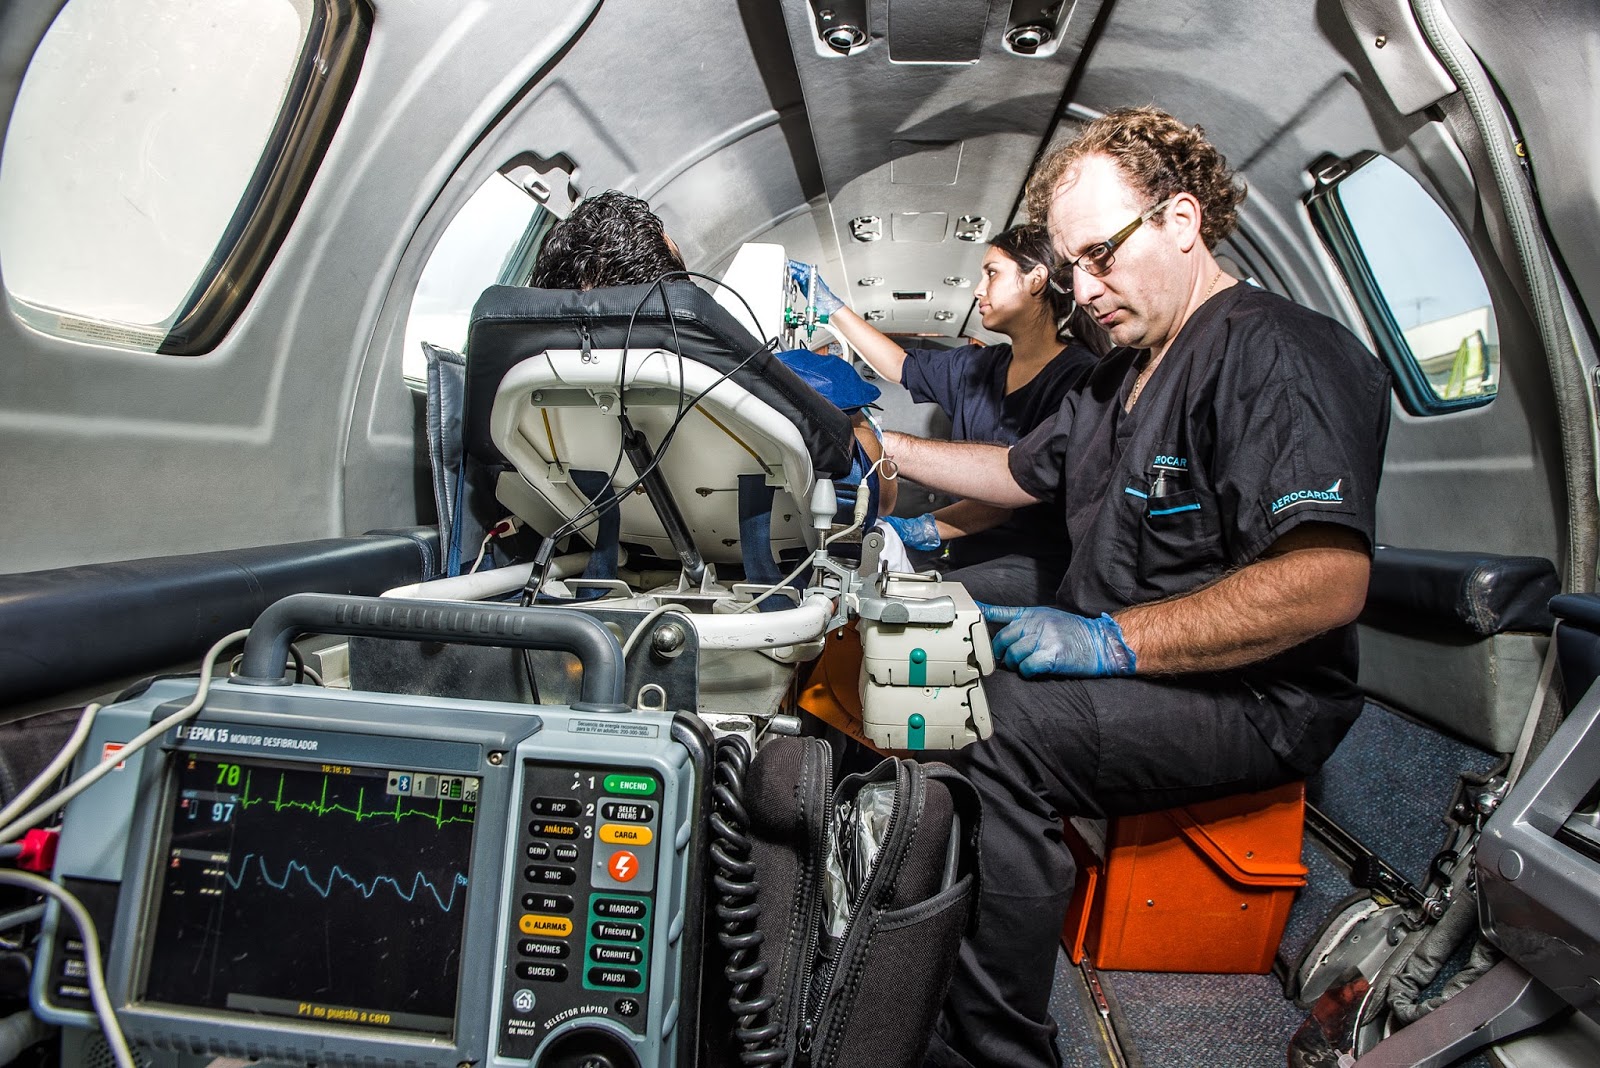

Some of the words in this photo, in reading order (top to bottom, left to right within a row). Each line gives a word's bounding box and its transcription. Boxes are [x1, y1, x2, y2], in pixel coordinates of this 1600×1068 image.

[1272, 490, 1343, 512] AEROCARDAL
[216, 729, 228, 742] 15
[230, 734, 262, 746] MONITOR
[262, 736, 318, 750] DESFIBRILADOR
[216, 763, 240, 786] 70
[417, 780, 422, 790] 1
[442, 782, 448, 794] 2
[588, 776, 595, 790] 1
[620, 780, 648, 791] ENCEND
[212, 802, 235, 822] 97
[552, 802, 567, 812] RCP
[586, 804, 594, 817] 2
[617, 812, 637, 820] ENERG
[544, 822, 574, 834] ANÁLISIS
[584, 826, 592, 839] 3
[614, 830, 638, 840] CARGA
[529, 846, 547, 856] DERIV
[544, 870, 562, 880] SINC
[544, 899, 556, 908] PNI
[610, 906, 640, 914] MARCAP
[534, 921, 566, 932] ALARMAS
[604, 928, 631, 937] FRECUEN
[526, 943, 560, 954] OPCIONES
[528, 967, 556, 977] SUCESO
[602, 972, 626, 983] PAUSA
[314, 1006, 326, 1016] no
[327, 1008, 358, 1020] puesto
[361, 1012, 367, 1021] a
[369, 1013, 390, 1024] cero
[544, 1007, 578, 1030] SELECTOR
[580, 1004, 608, 1015] RÁPIDO
[508, 1019, 536, 1028] PANTALLA
[517, 1028, 534, 1036] INICIO
